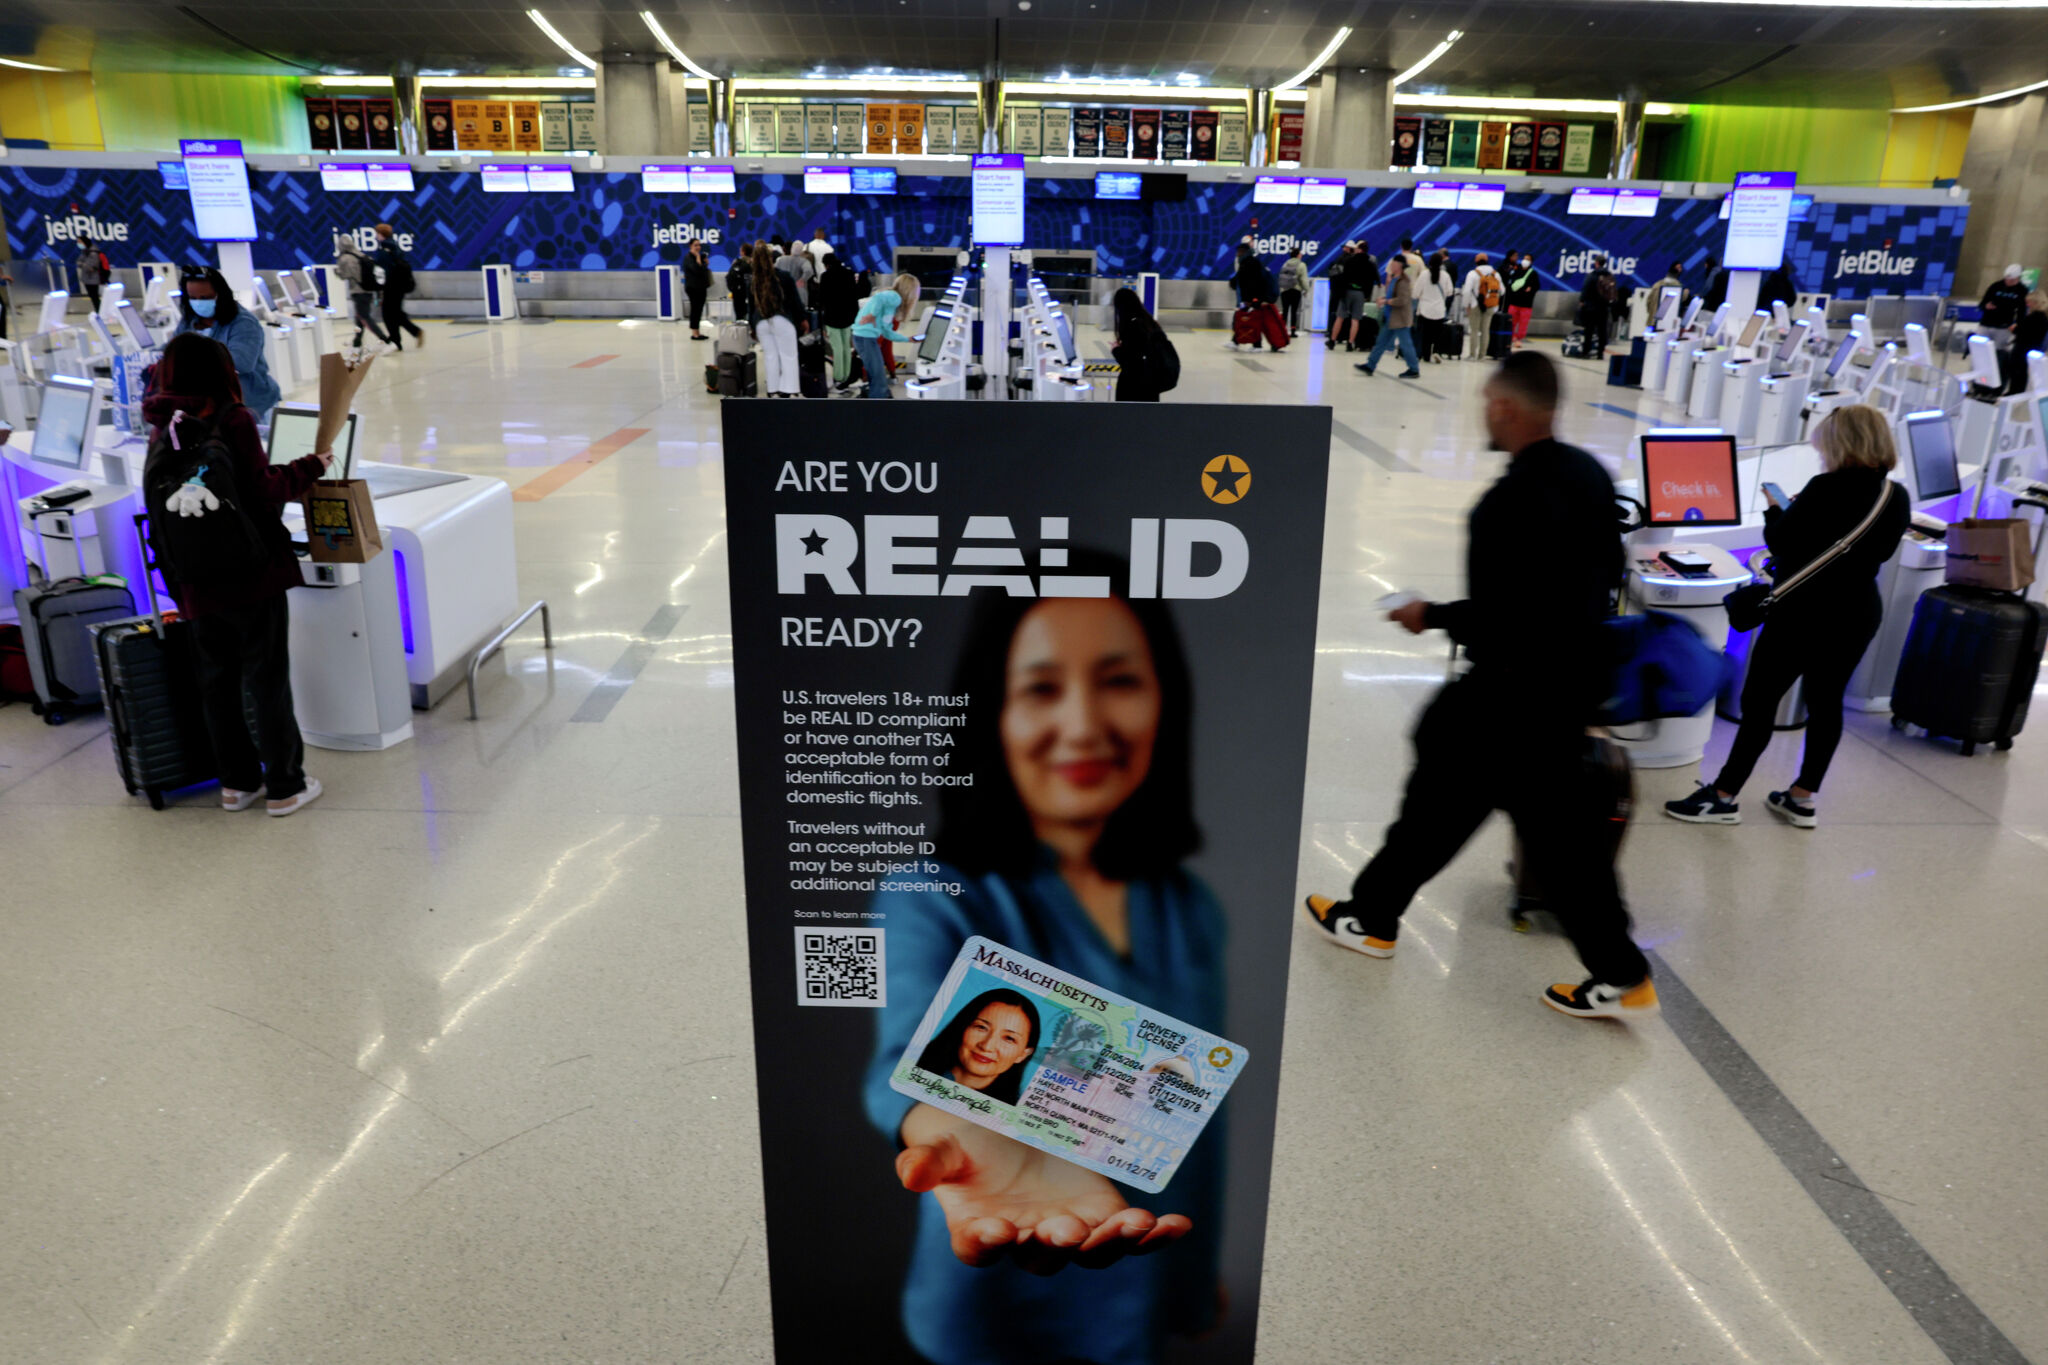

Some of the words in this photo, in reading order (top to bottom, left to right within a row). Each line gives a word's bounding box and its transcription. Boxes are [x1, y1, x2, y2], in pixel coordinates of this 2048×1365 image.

[44, 214, 128, 245] jetBlue
[652, 223, 720, 248] jetBlue
[1833, 249, 1915, 279] jetBlue
[775, 461, 848, 492] ARE
[857, 461, 937, 493] YOU
[1662, 481, 1703, 498] Check
[775, 514, 1110, 598] REAL
[1129, 518, 1249, 599] ID
[782, 617, 922, 647] READY?
[783, 691, 812, 704] U.S.
[815, 691, 887, 705] travelers
[893, 692, 923, 705] 18+
[928, 693, 970, 706] must
[784, 711, 806, 724] be
[811, 711, 852, 725] REAL
[857, 712, 873, 725] ID
[878, 713, 966, 729] compliant
[784, 734, 802, 744] or
[806, 731, 848, 745] have
[853, 733, 921, 746] another
[924, 733, 955, 746] TSA
[785, 752, 885, 767] acceptable
[889, 752, 928, 765] form
[933, 753, 949, 766] of
[786, 770, 895, 785] identification
[900, 772, 917, 785] to
[922, 773, 973, 786] board
[787, 790, 864, 804] domestic
[869, 791, 922, 808] flights.
[787, 821, 859, 834] Travelers
[863, 822, 925, 835] without
[789, 843, 811, 852] an
[816, 841, 914, 856] acceptable
[919, 842, 935, 854] ID
[790, 861, 826, 874] may
[831, 859, 853, 872] be
[858, 860, 919, 875] subject
[923, 861, 939, 873] to
[791, 878, 874, 891] additional
[880, 880, 965, 896] screening.
[972, 945, 1111, 1012] MASSACHUSETTS
[1136, 1029, 1180, 1052] LICENSE
[1139, 1019, 1187, 1044] DRIVER'S
[1099, 1048, 1144, 1071] 07/05/2024
[1042, 1069, 1088, 1093] SAMPLE
[1092, 1061, 1137, 1084] 01/12/2028
[1037, 1078, 1064, 1092] HAYLEY
[1028, 1094, 1042, 1103] APT.
[1032, 1087, 1044, 1095] 123
[1044, 1092, 1070, 1105] NORTH
[1070, 1103, 1087, 1112] MAIN
[1088, 1110, 1115, 1124] STREET
[1147, 1085, 1202, 1112] 01/12/1978
[1024, 1101, 1048, 1114] NORTH
[1077, 1122, 1088, 1130] MA
[1106, 1155, 1157, 1181] 01/12/78
